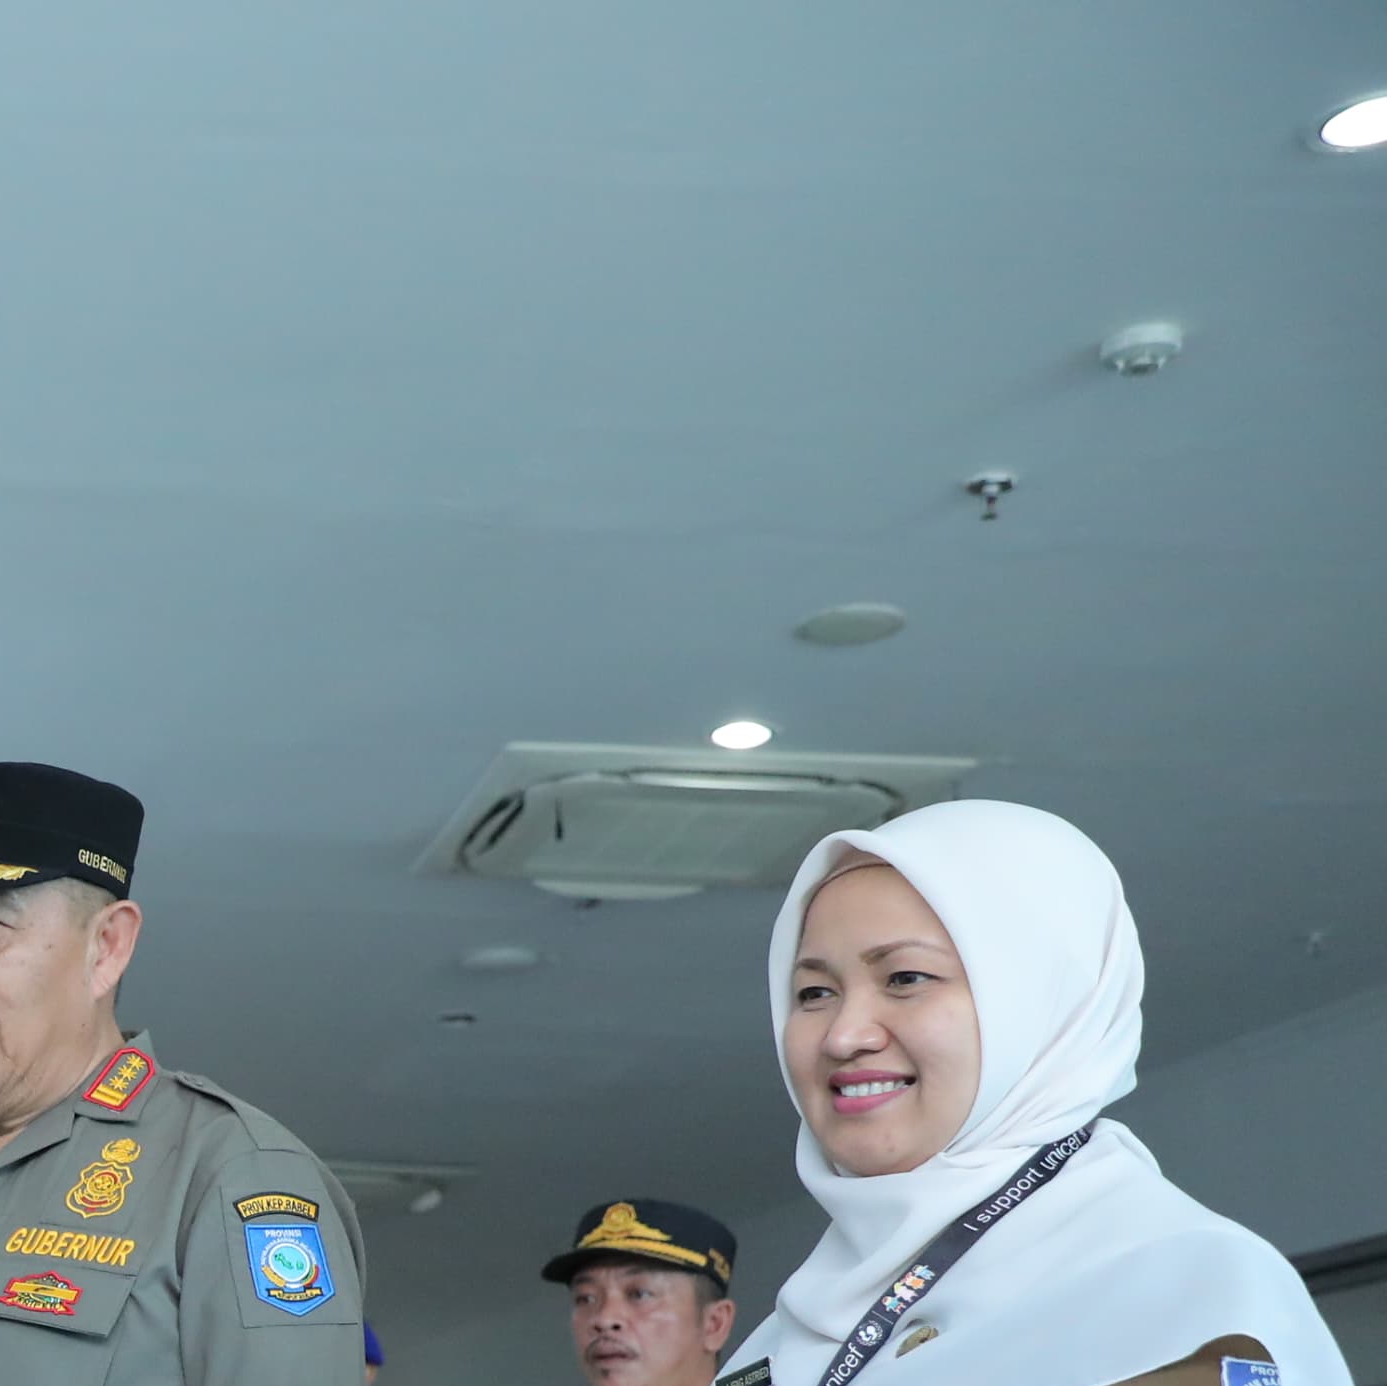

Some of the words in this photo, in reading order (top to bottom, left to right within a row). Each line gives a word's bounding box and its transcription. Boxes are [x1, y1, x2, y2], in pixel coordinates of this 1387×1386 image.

[78, 848, 127, 884] GUBERNUR
[963, 1223, 979, 1231] I
[976, 1167, 1044, 1223] support
[5, 1226, 136, 1267] GUBERNUR
